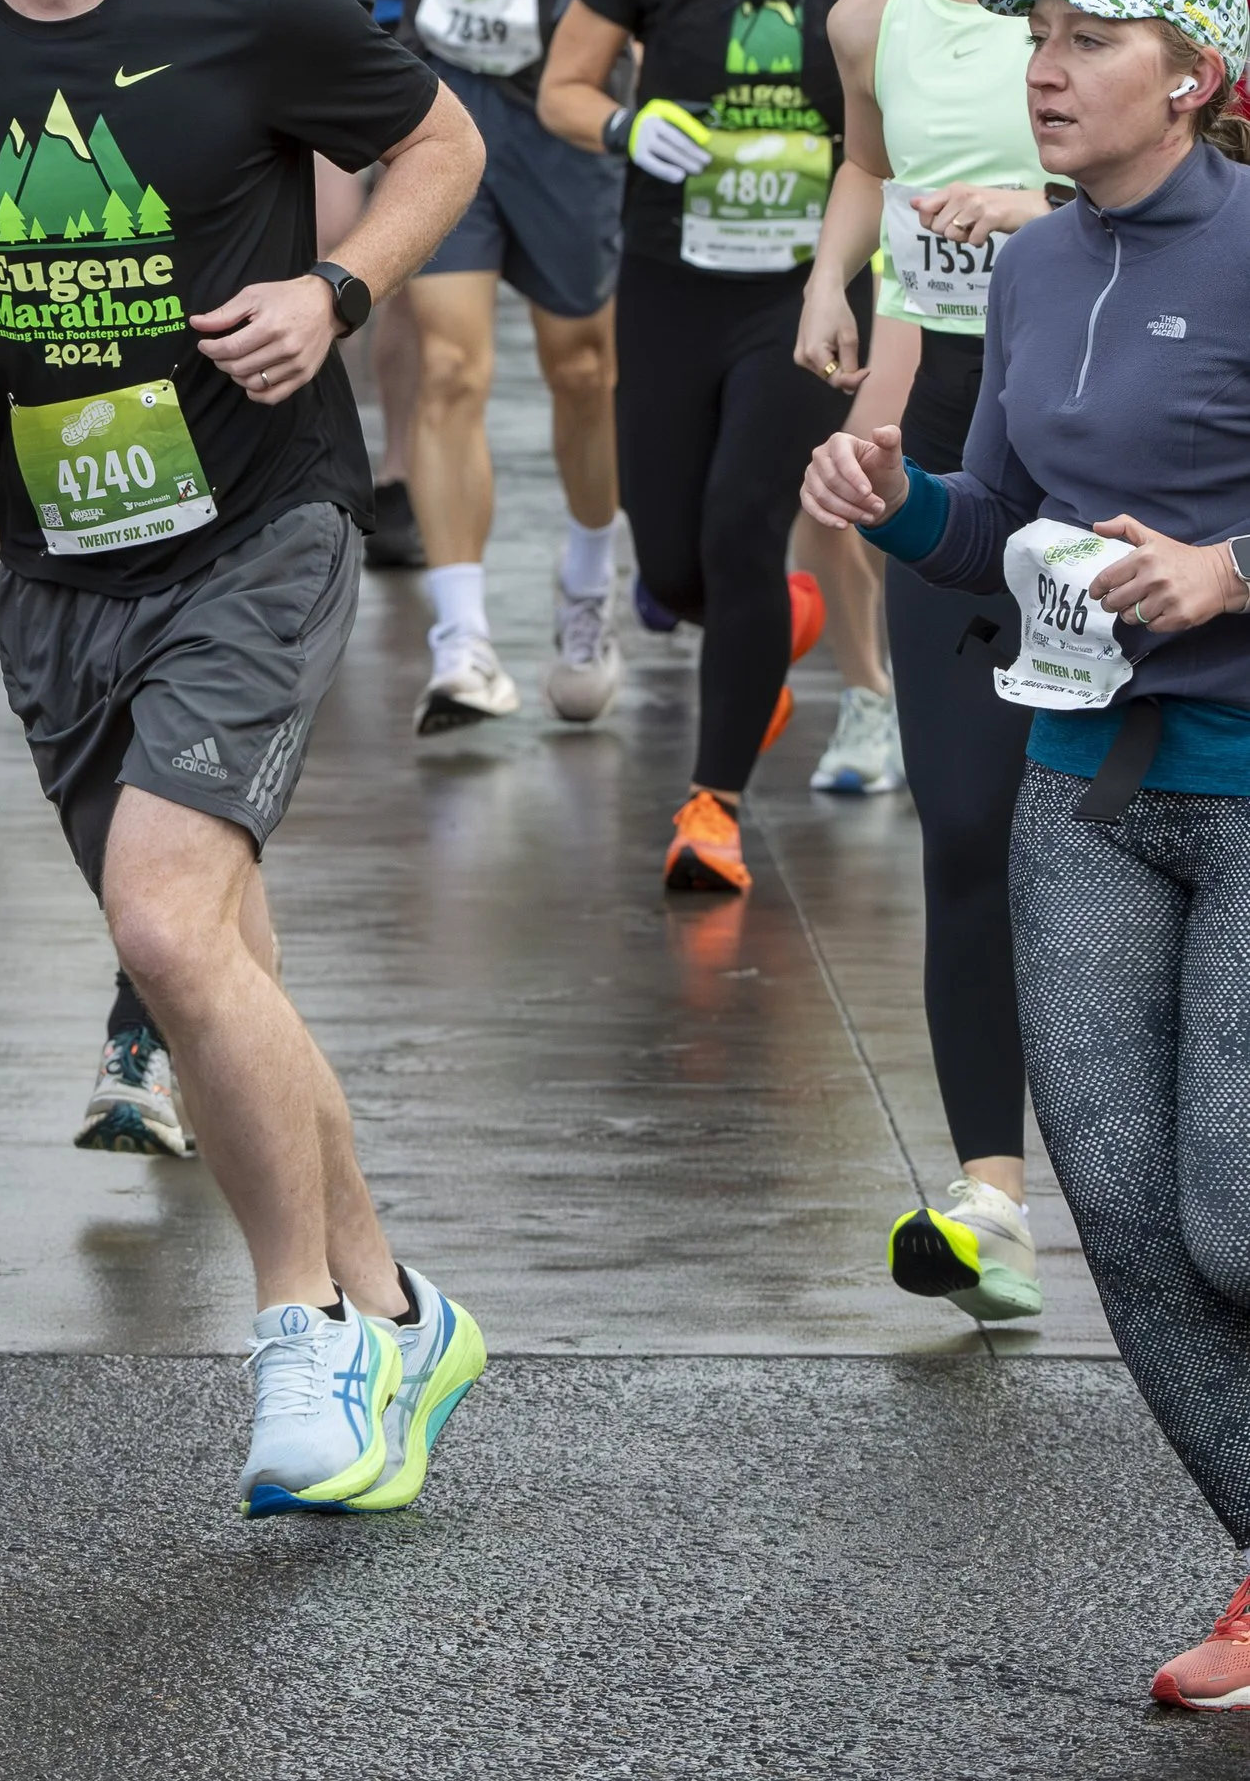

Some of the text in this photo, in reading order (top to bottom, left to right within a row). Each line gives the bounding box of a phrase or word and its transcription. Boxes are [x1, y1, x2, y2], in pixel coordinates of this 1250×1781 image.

[716, 169, 798, 206] 4807
[1146, 321, 1174, 330] NORTH
[1159, 315, 1177, 324] THE
[34, 330, 46, 340] in
[47, 327, 65, 340] the
[66, 327, 120, 342] Footsteps
[121, 327, 135, 338] of
[136, 321, 186, 338] Legends
[1151, 329, 1171, 337] FACE
[44, 342, 122, 369] 2024
[145, 395, 154, 404] C
[58, 445, 156, 502] 4240
[133, 493, 171, 508] PeaceHealth
[77, 530, 122, 549] TWENTY
[1037, 573, 1088, 635] 9266
[171, 756, 228, 780] adidas
